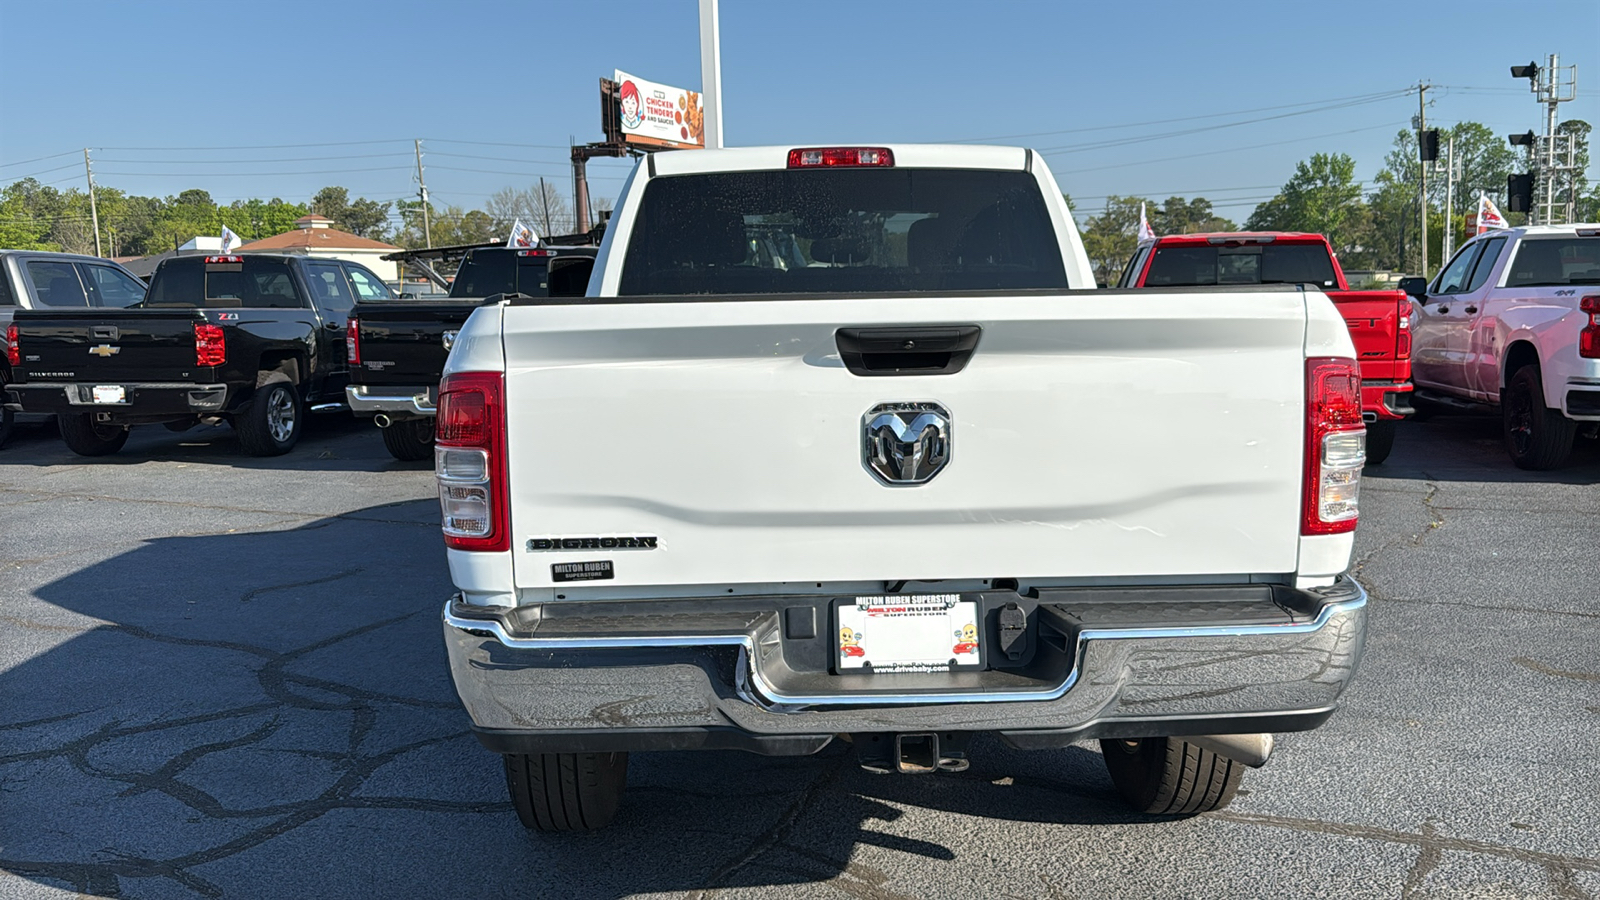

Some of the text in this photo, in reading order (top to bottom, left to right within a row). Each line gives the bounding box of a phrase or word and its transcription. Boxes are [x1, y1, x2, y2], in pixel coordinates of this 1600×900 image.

[646, 97, 674, 109] CHICKEN
[646, 106, 674, 118] TENDERS
[647, 115, 674, 125] AND SAUCES
[218, 312, 239, 320] Z71
[554, 561, 611, 574] MILTON RUBEN
[565, 571, 603, 579] SUPERSTORE
[855, 594, 960, 605] MILTON RUBEN SUPERSTORE
